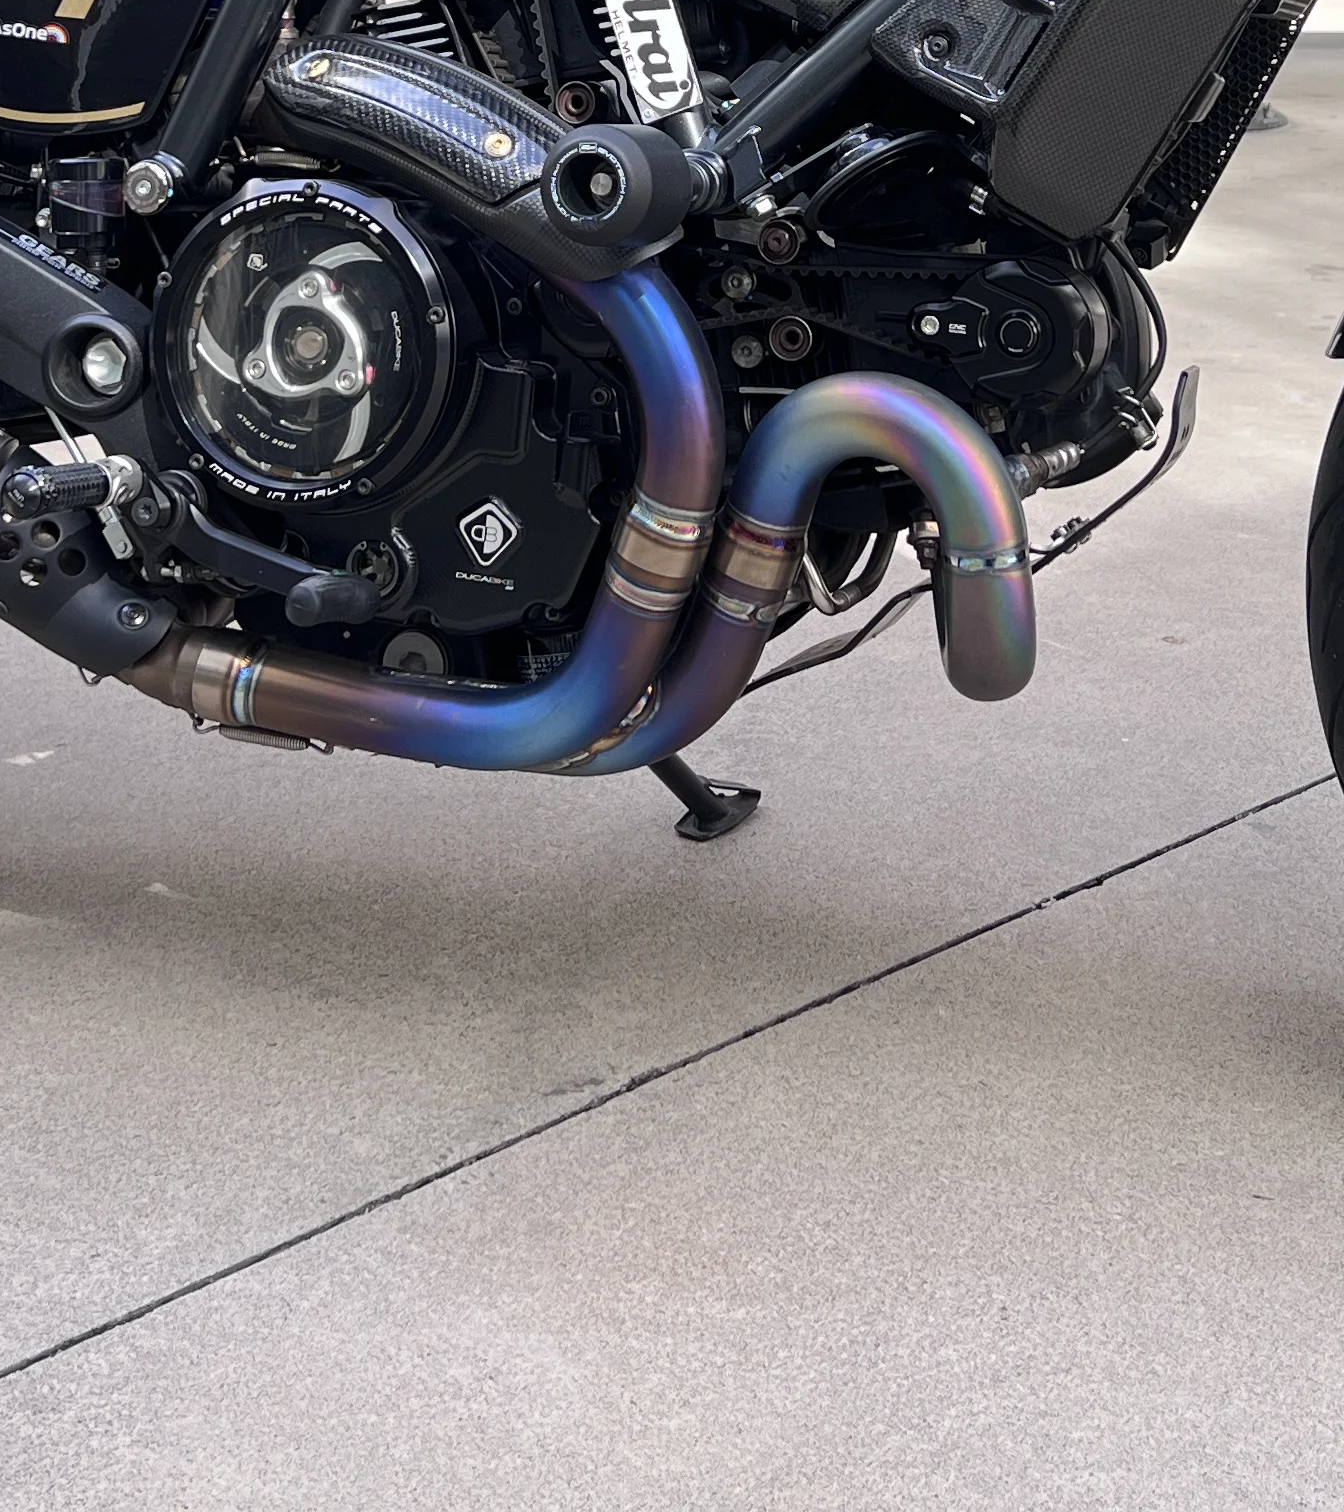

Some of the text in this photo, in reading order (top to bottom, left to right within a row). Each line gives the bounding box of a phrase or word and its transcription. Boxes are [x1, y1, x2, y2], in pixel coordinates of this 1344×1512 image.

[611, 9, 639, 76] HELMET
[220, 194, 382, 235] SPECIAL PARTS
[17, 234, 102, 287] GEARS
[209, 462, 351, 502] MADE IN ITALY
